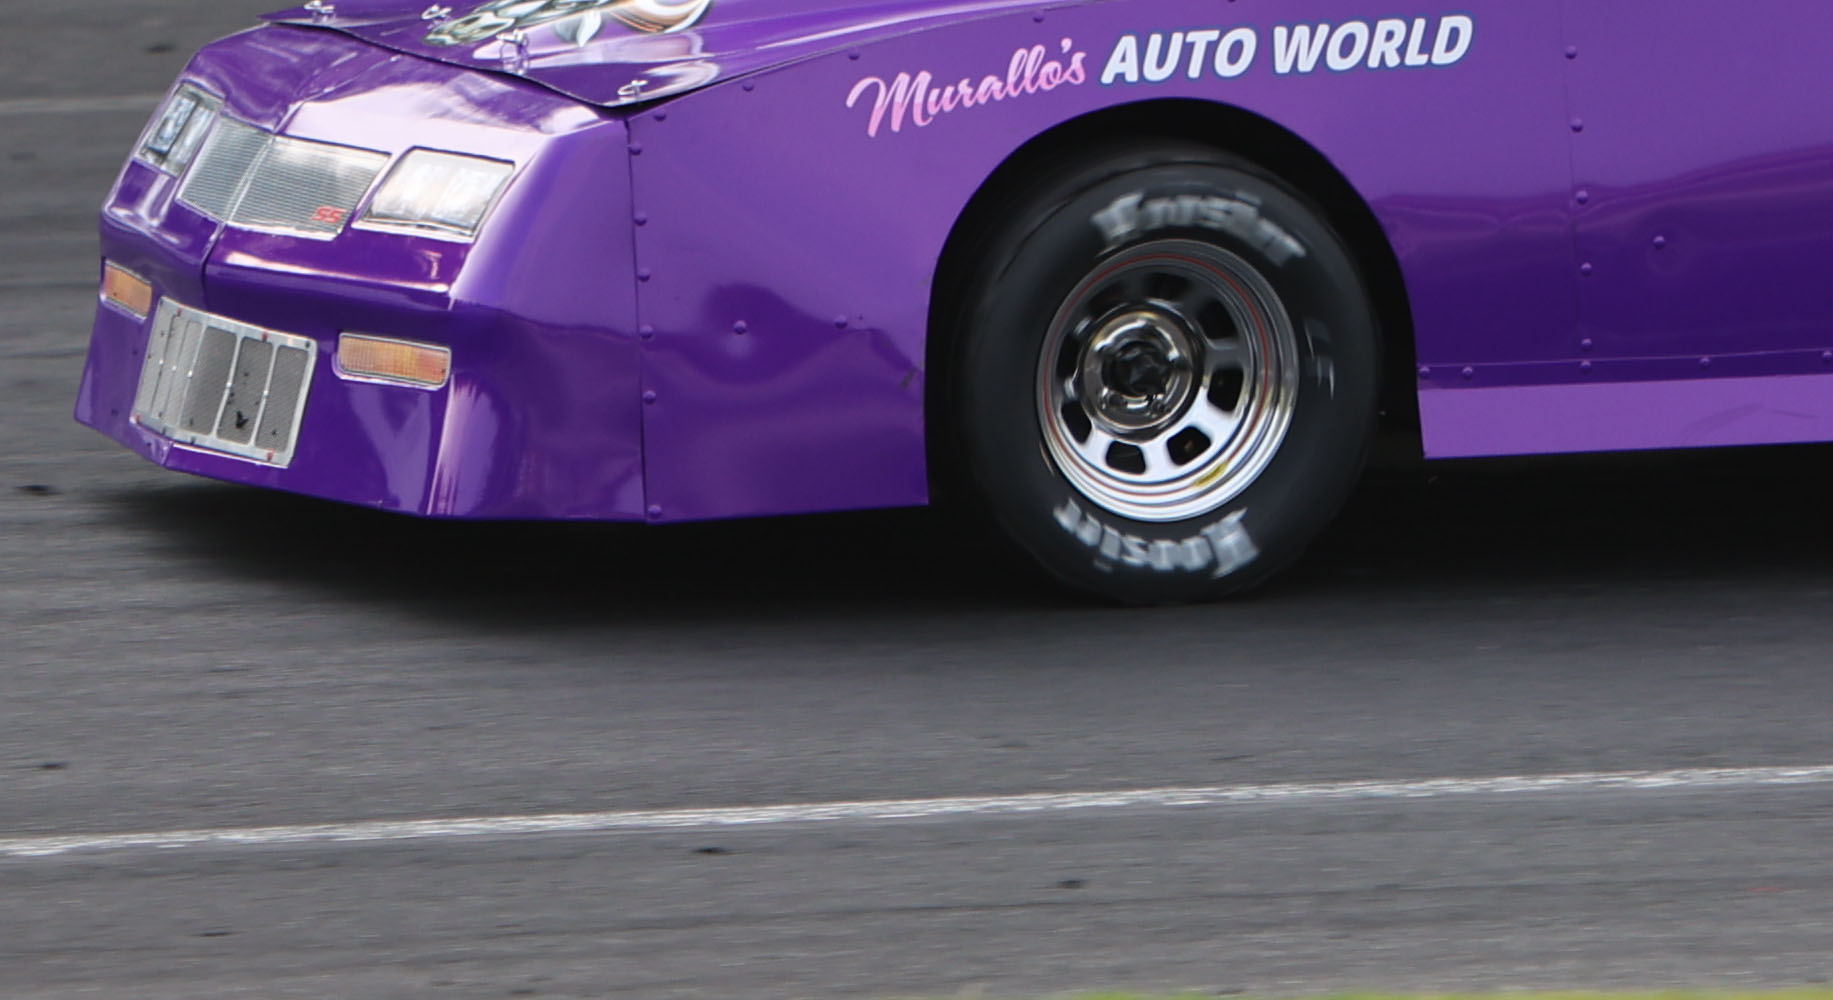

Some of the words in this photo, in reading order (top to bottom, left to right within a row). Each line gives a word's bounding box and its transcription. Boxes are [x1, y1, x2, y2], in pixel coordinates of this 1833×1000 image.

[846, 37, 1086, 137] Murallo's
[1099, 26, 1258, 85] AUTO
[1272, 14, 1474, 74] WORLD
[312, 205, 348, 223] SS
